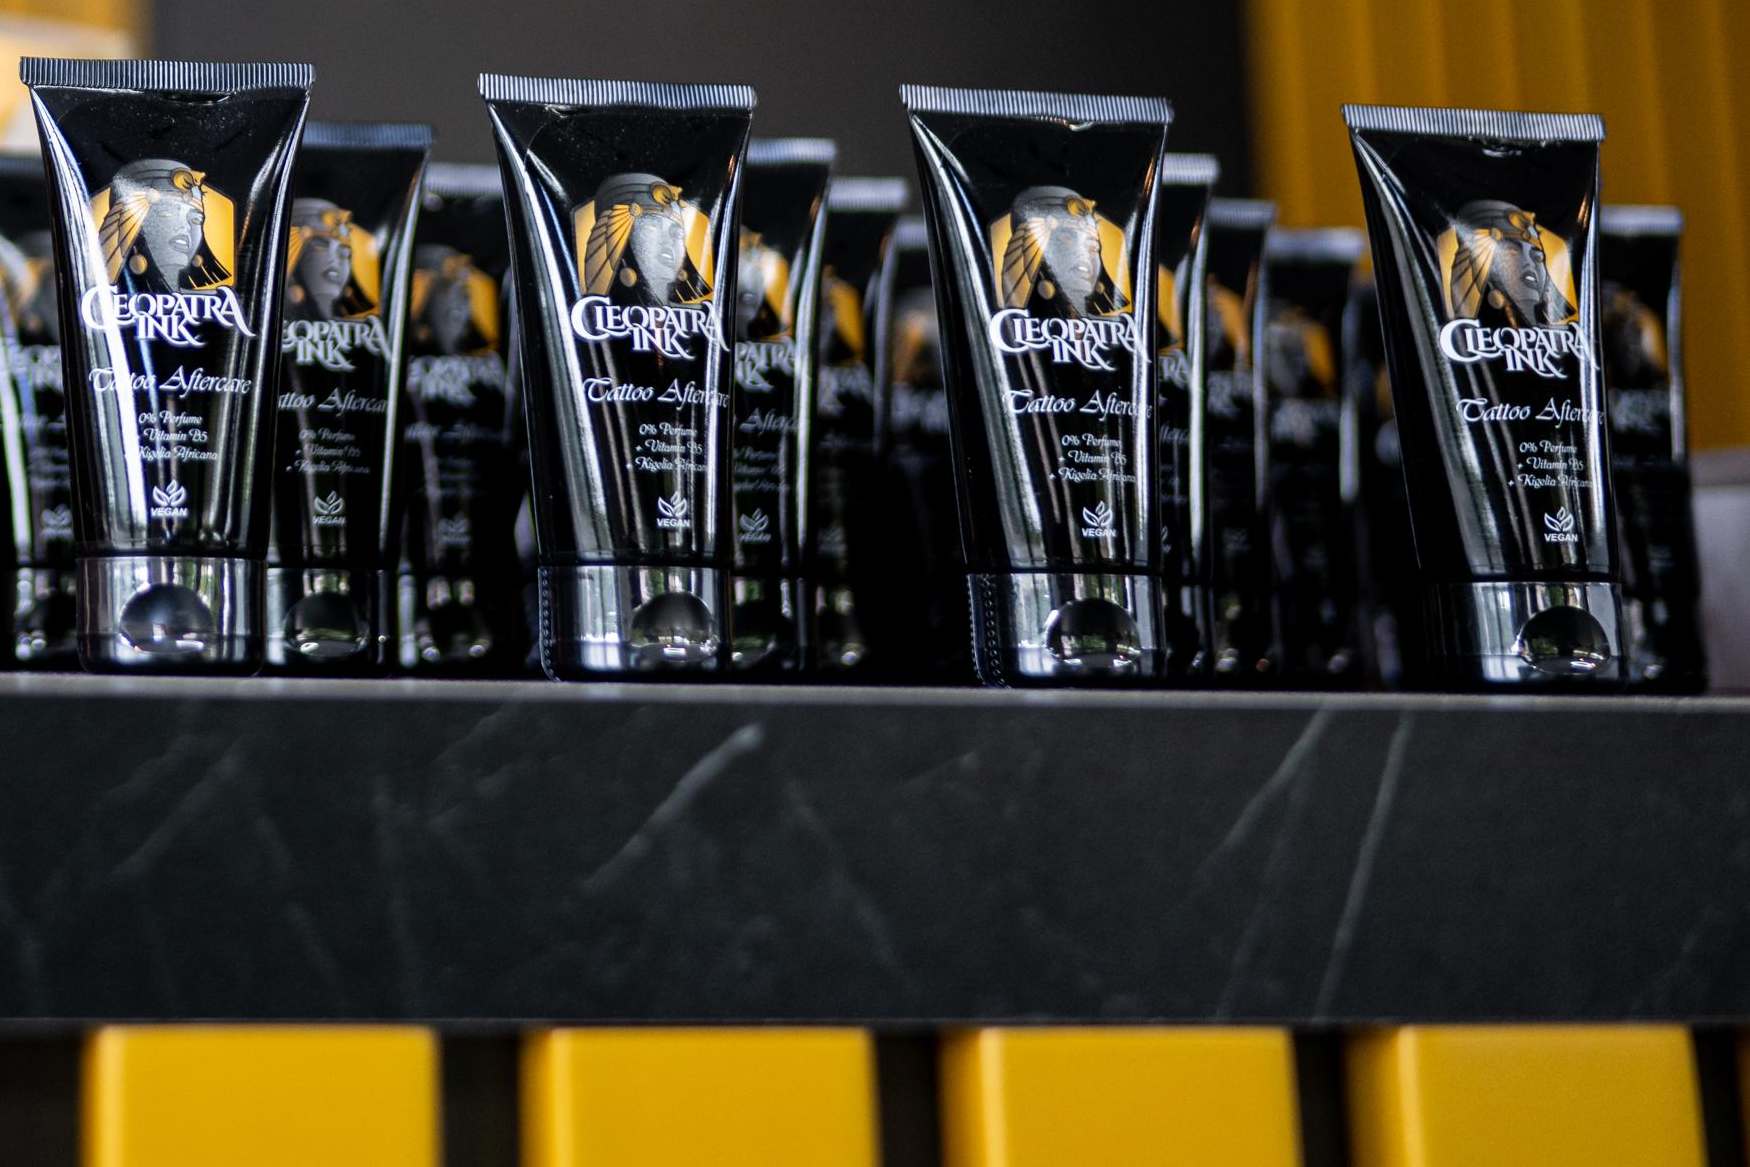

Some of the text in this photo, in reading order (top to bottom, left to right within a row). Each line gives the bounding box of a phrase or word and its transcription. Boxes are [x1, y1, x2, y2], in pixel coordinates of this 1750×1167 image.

[81, 285, 256, 337] CEOPATRA
[571, 296, 730, 352] CLEOPATRA
[137, 311, 205, 346] INK
[631, 323, 695, 360] INK
[989, 309, 1151, 363] CLEOPATRA
[296, 336, 356, 371] INK
[1050, 336, 1116, 370] INK
[1440, 319, 1600, 370] CLEOPATRA
[1502, 345, 1568, 378] INK
[89, 365, 252, 398] Too Aftercare
[583, 377, 730, 410] Tattoo Afterre
[139, 410, 203, 426] 0% Perfume
[1002, 389, 1152, 421] Tattoo Afterce
[1456, 398, 1531, 422] Tattoo
[1535, 397, 1603, 428] Afterce
[144, 428, 208, 442] Vitamin B5
[639, 423, 657, 435] 0%
[1061, 435, 1080, 446] 0%
[645, 439, 686, 452] Vitamin
[1068, 450, 1110, 463] Vitamin
[1519, 440, 1578, 454] 0% Perfume
[1526, 457, 1567, 469] Vitamin
[150, 508, 188, 516] VEGAN
[657, 518, 691, 527] VEGAN
[1082, 528, 1116, 537] VEGAN
[1544, 533, 1578, 542] VEGAN
